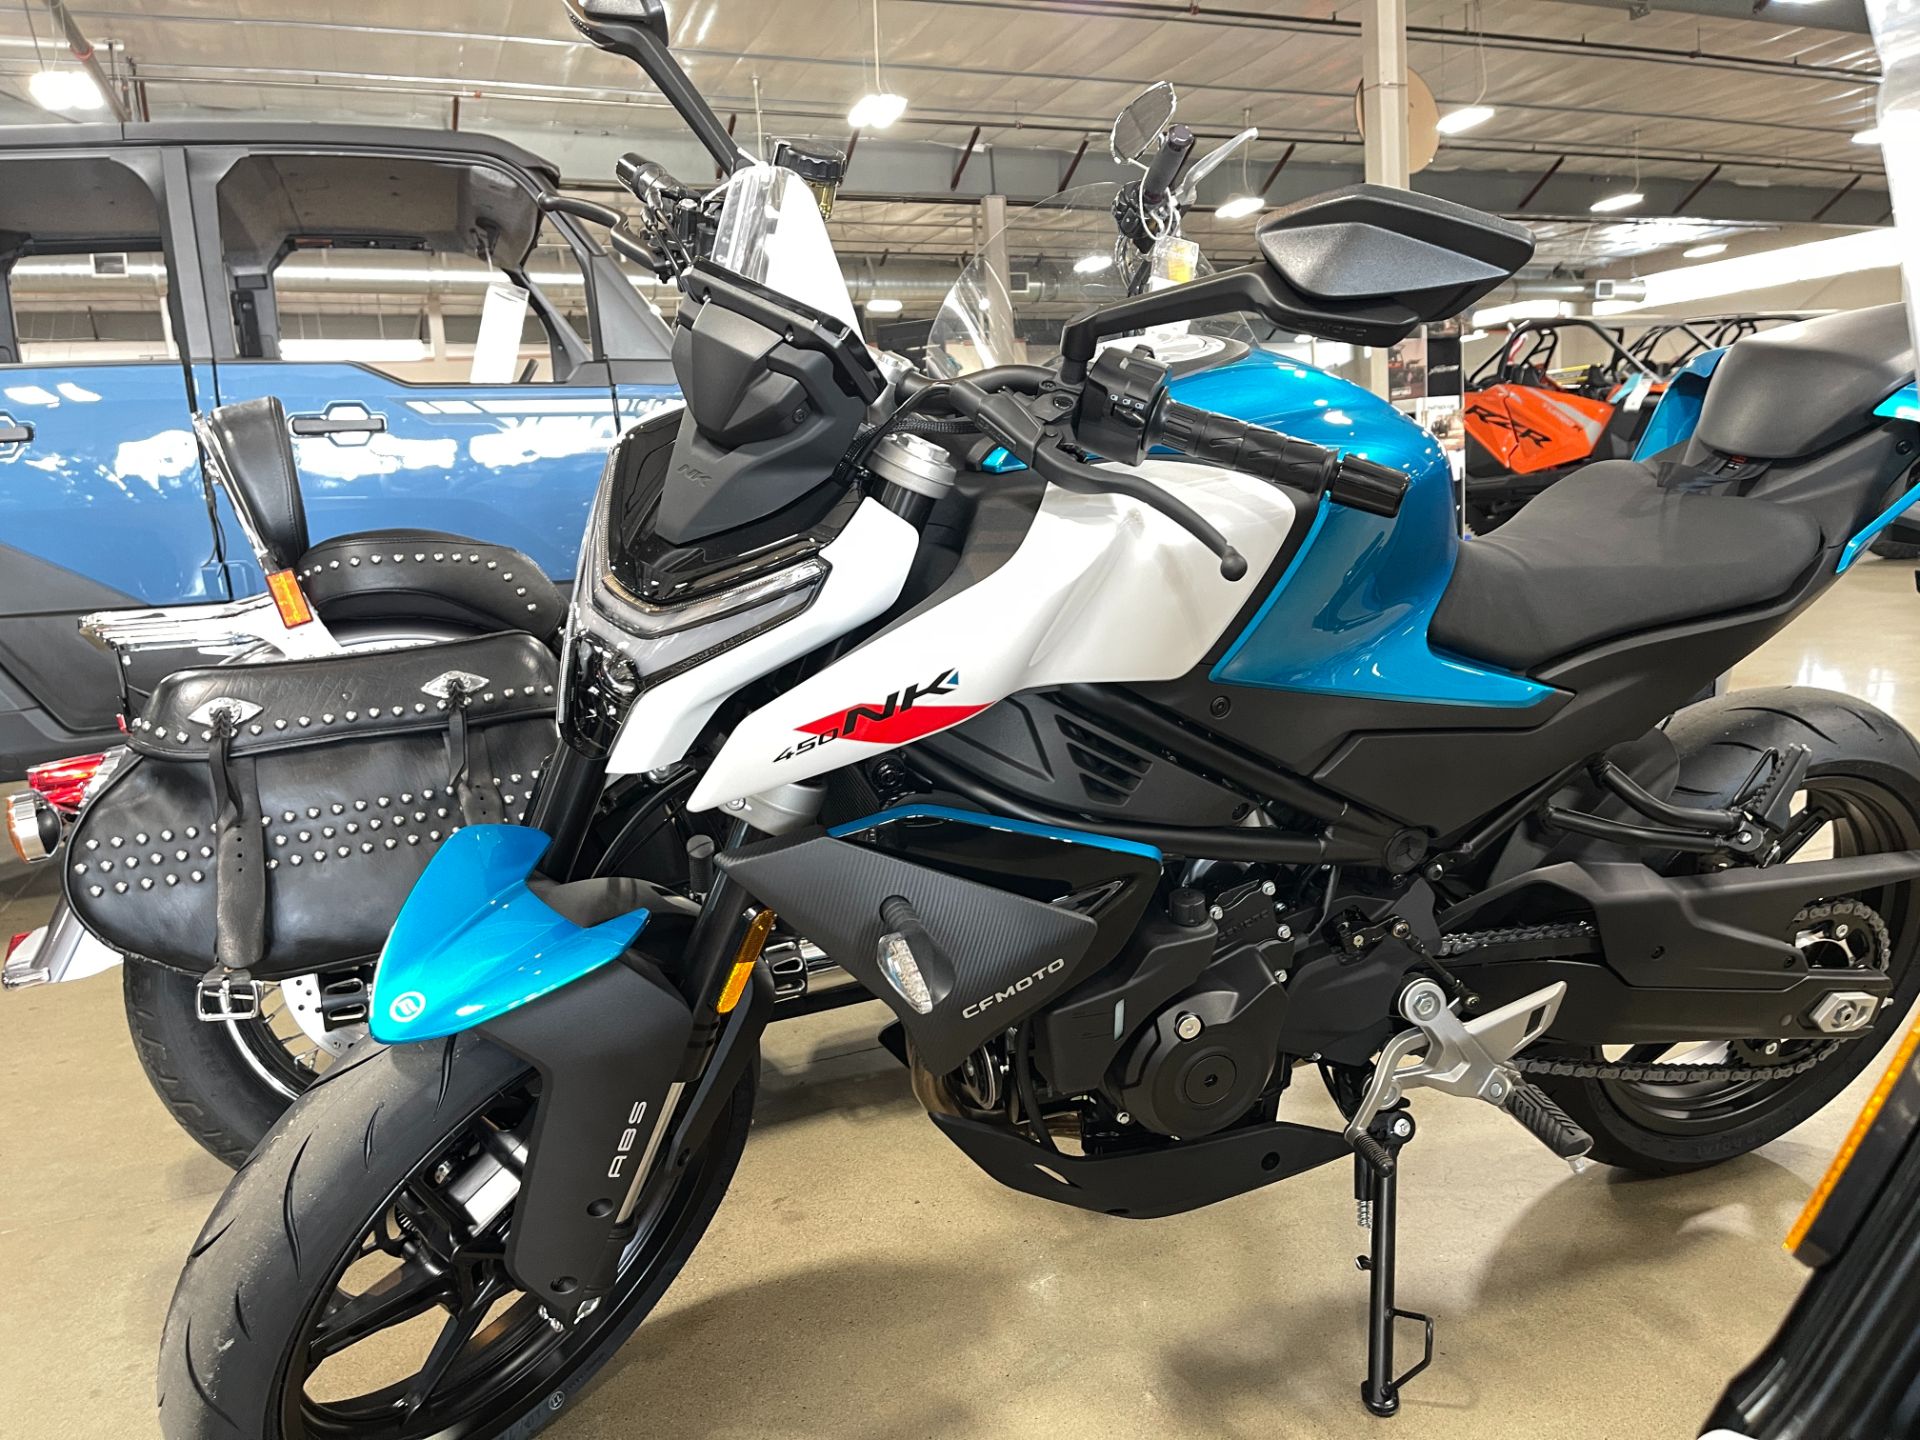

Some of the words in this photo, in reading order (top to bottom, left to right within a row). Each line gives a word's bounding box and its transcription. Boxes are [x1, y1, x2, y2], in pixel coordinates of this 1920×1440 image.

[1465, 404, 1553, 448] RZR
[677, 464, 713, 487] NK
[772, 727, 839, 763] 450
[842, 667, 957, 736] NK
[962, 957, 1066, 1020] CFMOTO
[607, 1101, 648, 1178] ABS
